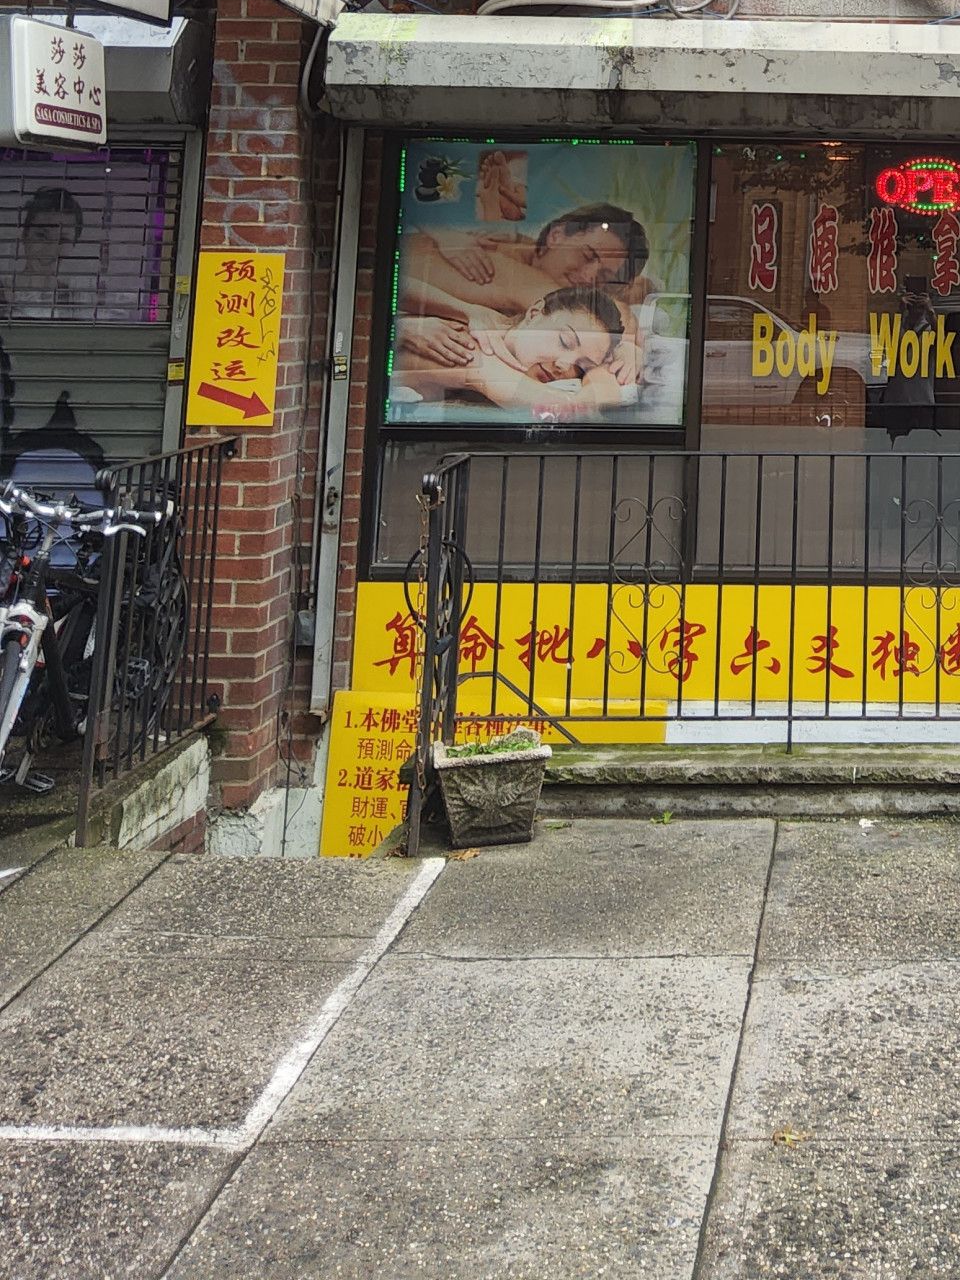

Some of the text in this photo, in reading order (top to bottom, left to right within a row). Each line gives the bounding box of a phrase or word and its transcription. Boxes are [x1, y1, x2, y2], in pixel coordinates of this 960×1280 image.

[34, 67, 102, 107] 美容中心
[211, 260, 261, 382] 预测改运
[752, 312, 956, 395] Body Work
